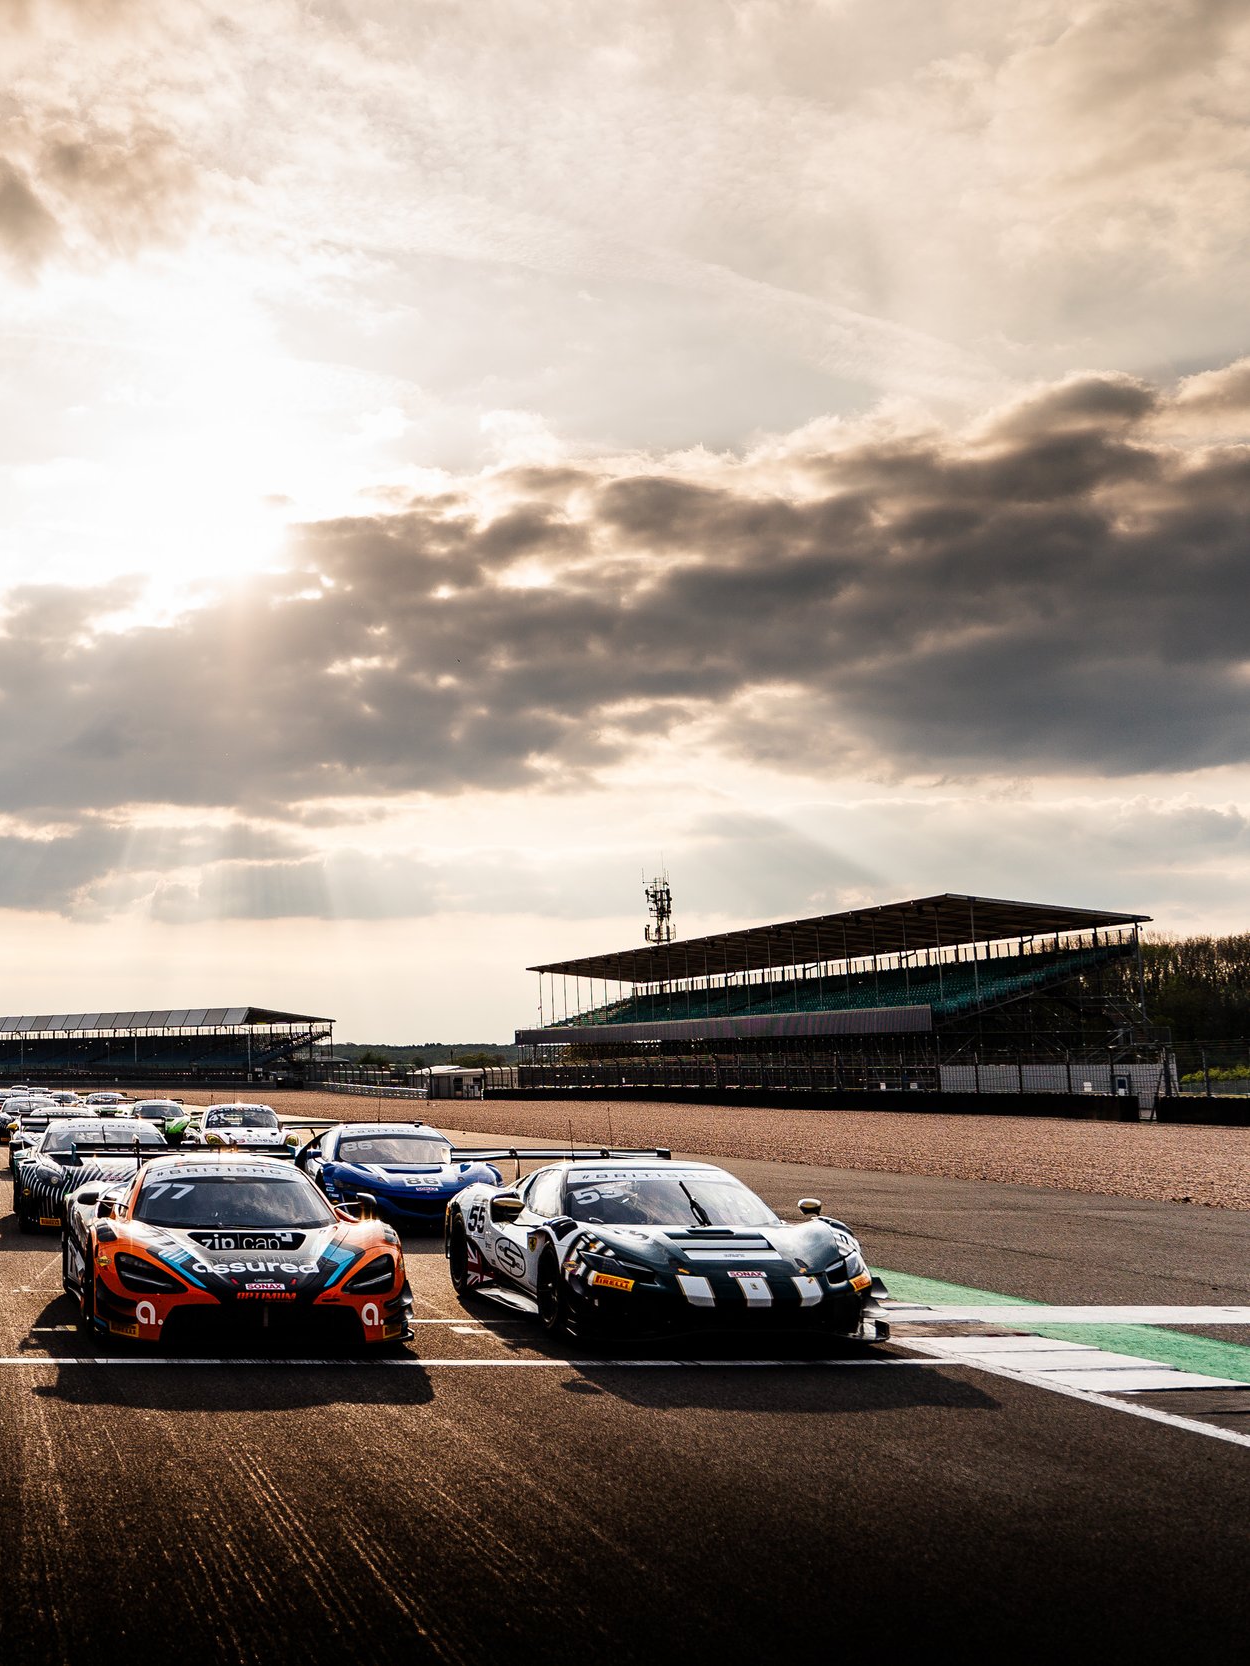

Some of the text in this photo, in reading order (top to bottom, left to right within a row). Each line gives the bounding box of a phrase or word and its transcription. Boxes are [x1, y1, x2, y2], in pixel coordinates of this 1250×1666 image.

[343, 1141, 373, 1152] 86
[405, 1176, 439, 1186] 86
[148, 1184, 195, 1200] 77
[572, 1187, 624, 1206] 55
[467, 1205, 486, 1234] 55
[201, 1234, 235, 1250] zip
[192, 1262, 320, 1274] assured
[595, 1274, 630, 1289] PIRELLI
